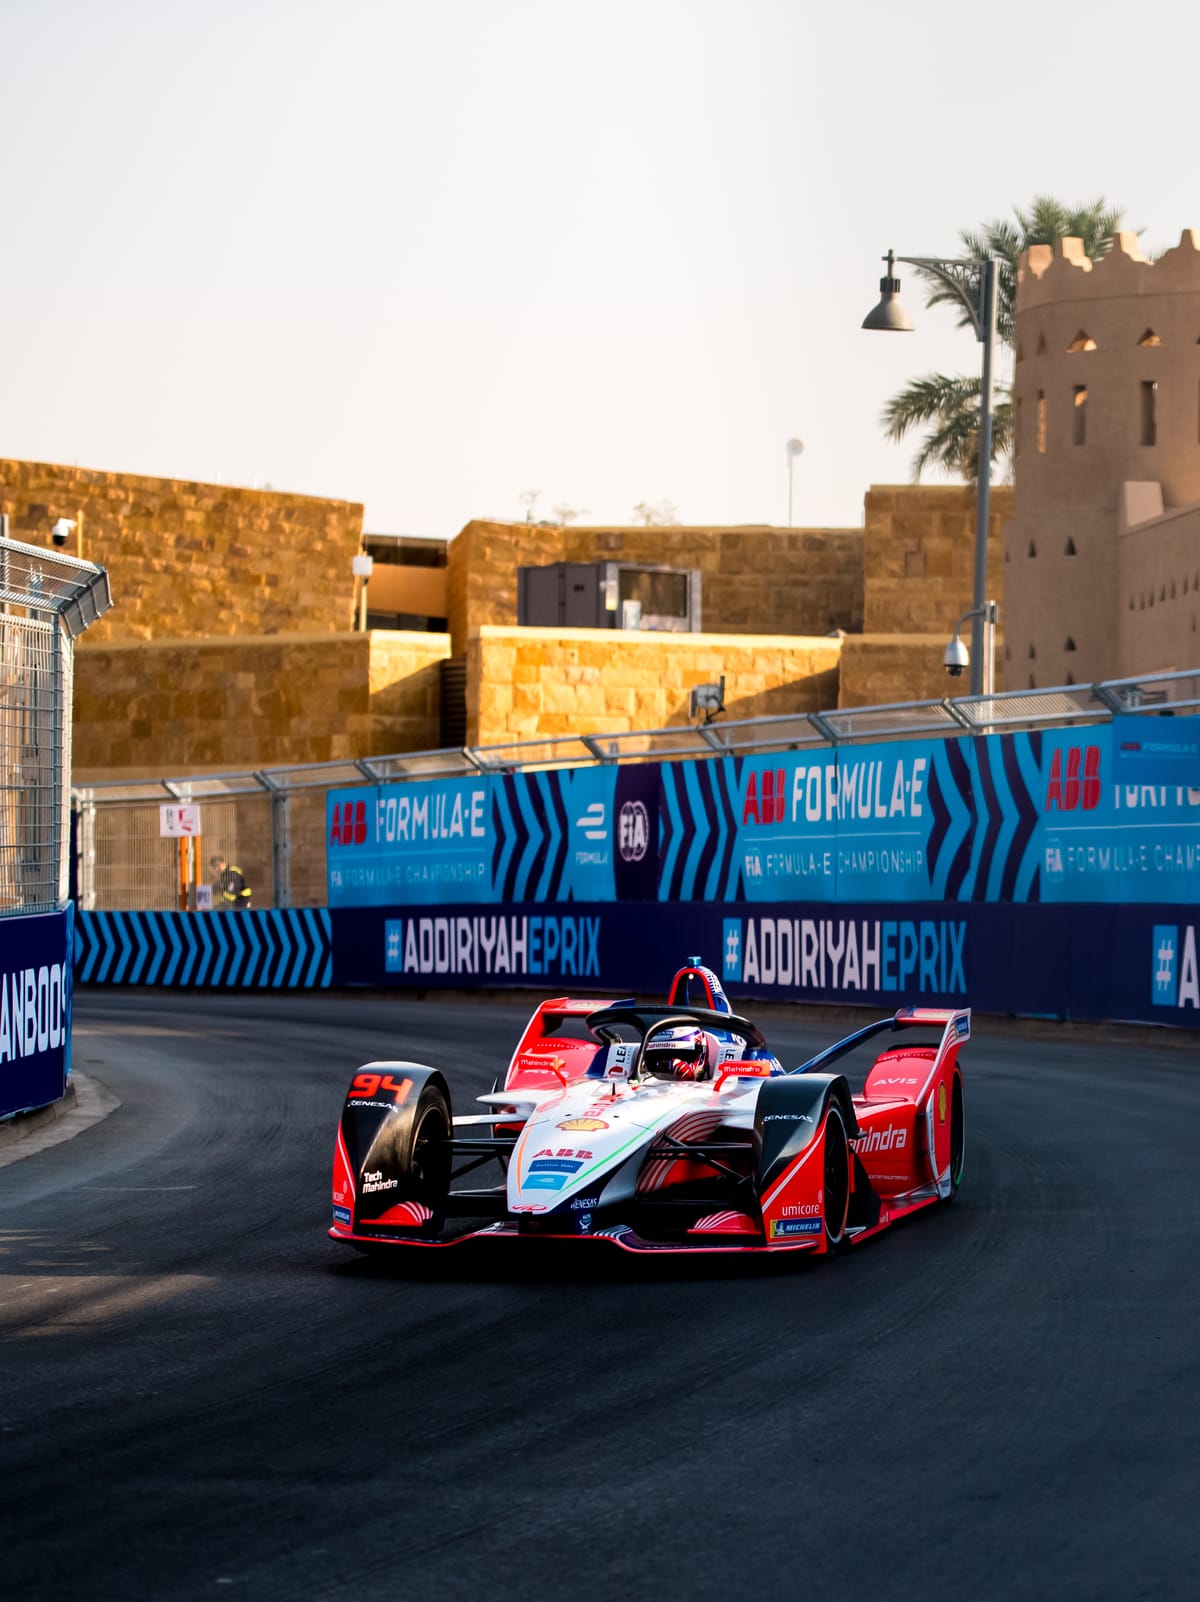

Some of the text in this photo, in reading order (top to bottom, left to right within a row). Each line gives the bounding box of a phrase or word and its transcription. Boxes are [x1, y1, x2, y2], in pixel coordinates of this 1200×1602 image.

[1045, 745, 1101, 812] ABB
[742, 768, 786, 825] ABB
[330, 800, 367, 847] ABB
[838, 849, 924, 876] CHAMPIONSHIP
[873, 1077, 919, 1086] AVIS
[348, 1073, 414, 1106] 94
[531, 1148, 593, 1159] ABB
[364, 1170, 382, 1183] Tech
[362, 1179, 398, 1194] Mahindra
[782, 1202, 820, 1216] umicore
[785, 1222, 820, 1232] MICHELIN
